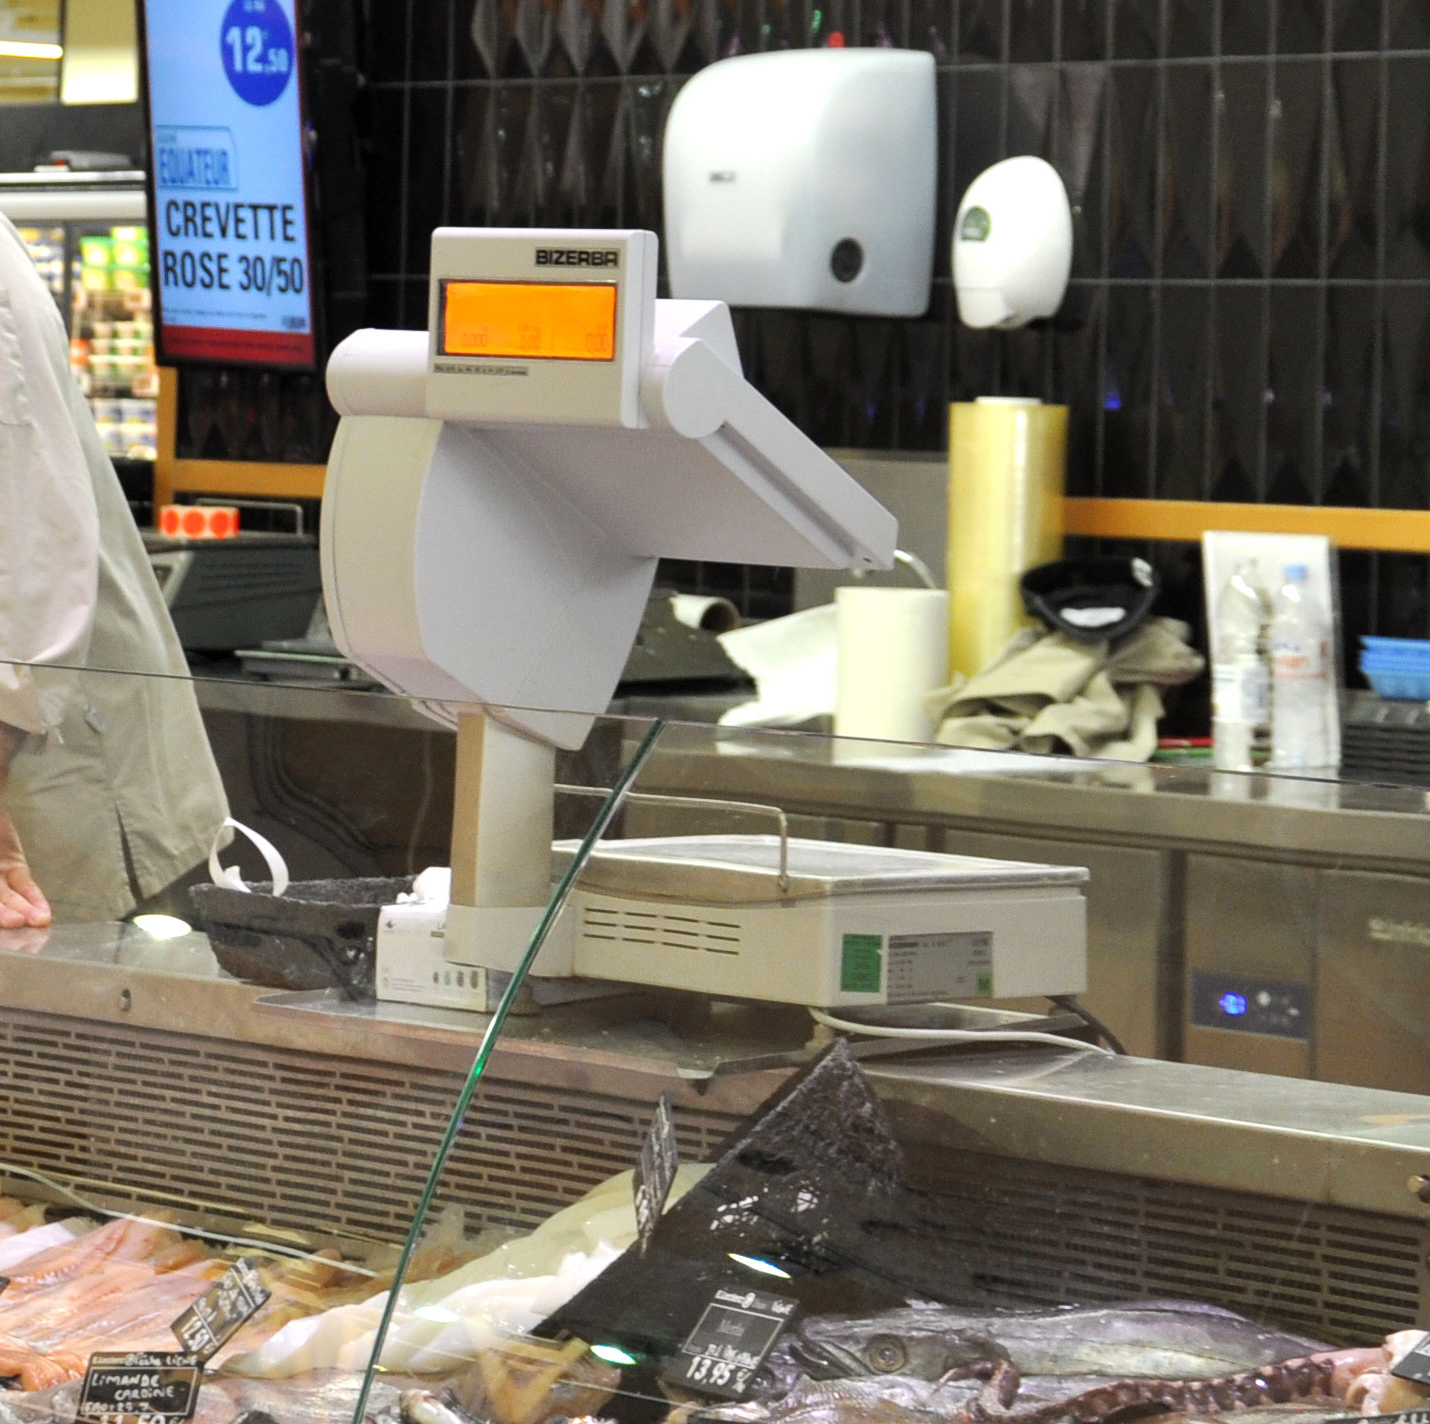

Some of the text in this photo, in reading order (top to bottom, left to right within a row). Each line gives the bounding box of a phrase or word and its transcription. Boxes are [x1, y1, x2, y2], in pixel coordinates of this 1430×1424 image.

[165, 199, 296, 243] CREVETTE
[163, 249, 304, 297] ROSE 30/50
[535, 249, 619, 267] BIZERBA
